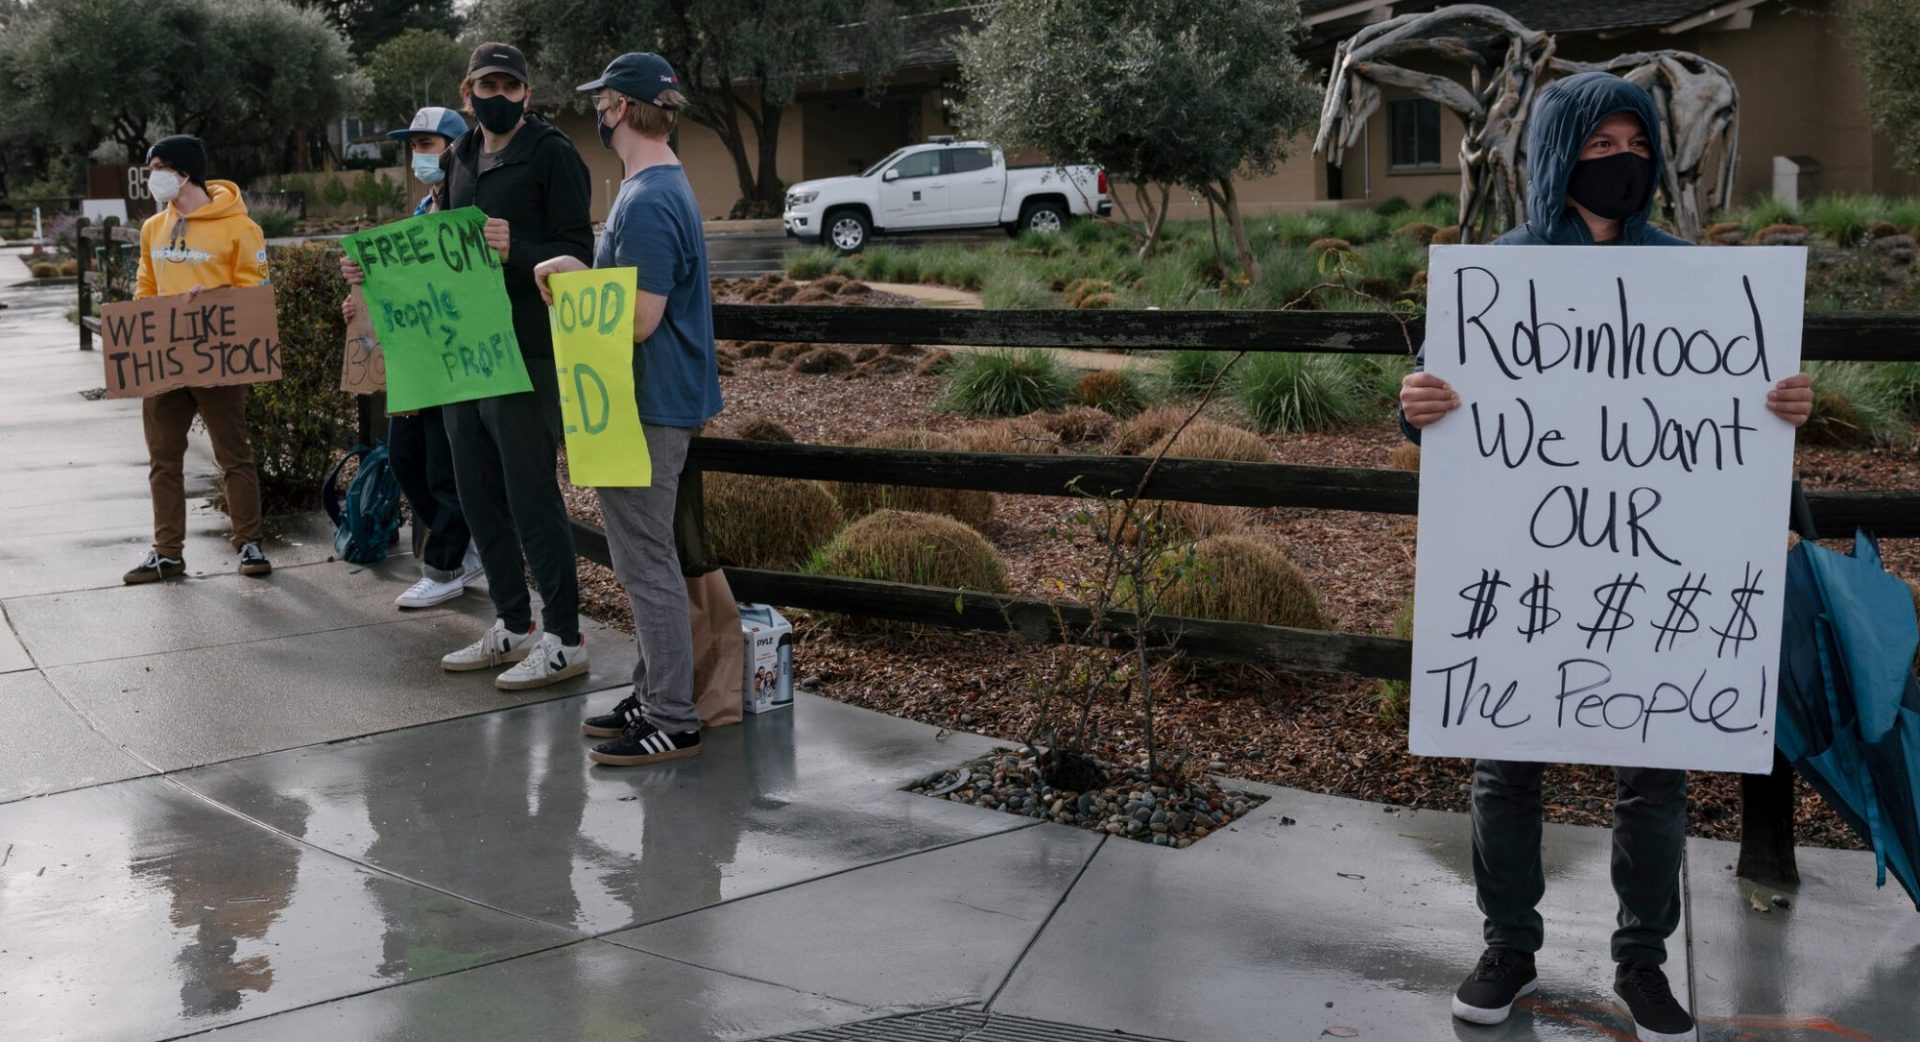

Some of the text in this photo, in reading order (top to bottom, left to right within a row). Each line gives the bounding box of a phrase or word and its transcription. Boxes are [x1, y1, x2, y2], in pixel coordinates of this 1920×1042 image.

[355, 223, 435, 276] FREE
[106, 304, 236, 347] WE LIKE
[379, 281, 462, 337] People
[550, 281, 626, 335] OOD
[1454, 266, 1771, 382] Robinhood
[109, 337, 282, 390] THIS STOCK
[441, 331, 514, 383] PROFI
[1470, 397, 1758, 472] We Want
[1530, 485, 1682, 566] OUR
[756, 636, 774, 647] PYLE
[1426, 656, 1768, 743] The People!
